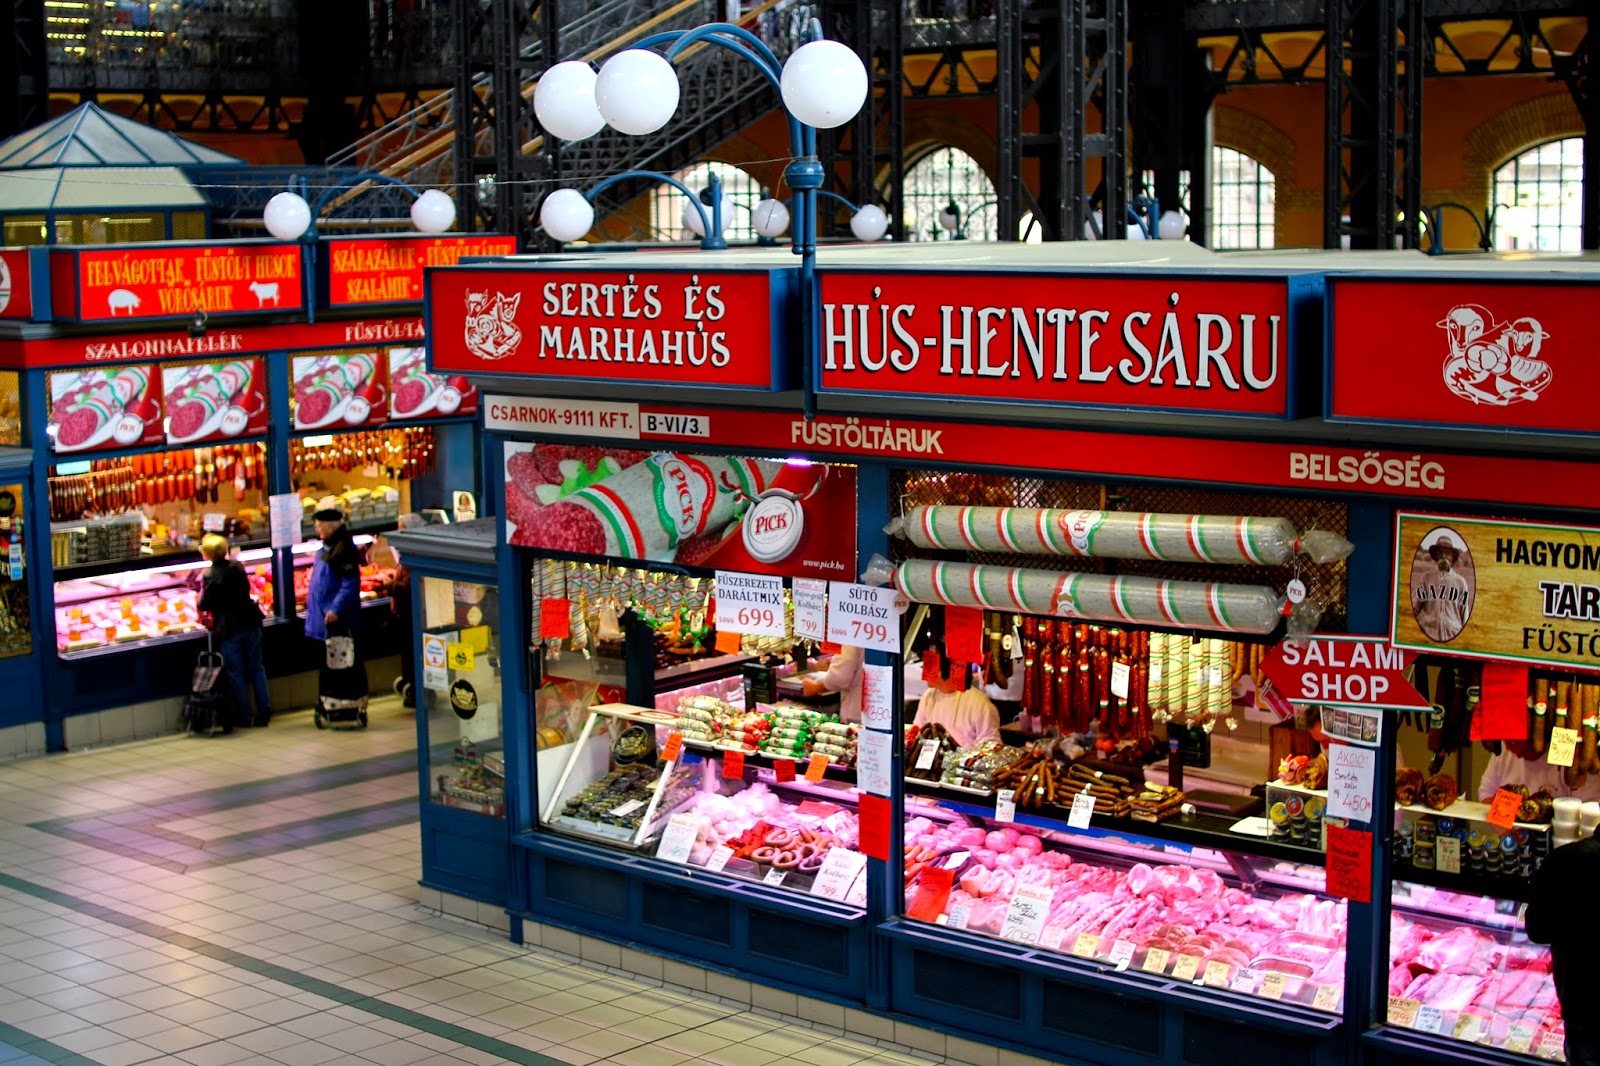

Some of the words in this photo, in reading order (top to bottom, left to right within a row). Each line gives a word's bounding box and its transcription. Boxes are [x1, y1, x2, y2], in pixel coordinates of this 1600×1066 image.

[542, 273, 663, 319] SERTÉS
[684, 274, 726, 321] ÉS
[538, 321, 731, 368] MARHAHÚS
[490, 404, 595, 427] CSARNOK-9111
[600, 411, 634, 430] KFT.
[647, 415, 703, 435] B-VI/3.
[1290, 450, 1446, 490] BELSŐSÉG
[668, 465, 694, 526] PICK
[754, 512, 788, 536] PICK
[803, 559, 845, 571] www.pick.hu
[718, 588, 781, 606] DARÁLTMIX
[848, 586, 878, 602] SÜTŐ
[1416, 581, 1470, 607] GAZDA
[1540, 580, 1600, 621] TAR
[838, 601, 889, 619] KOLBÁSZ
[1281, 638, 1405, 671] SALAMI
[1301, 671, 1390, 702] SHOP
